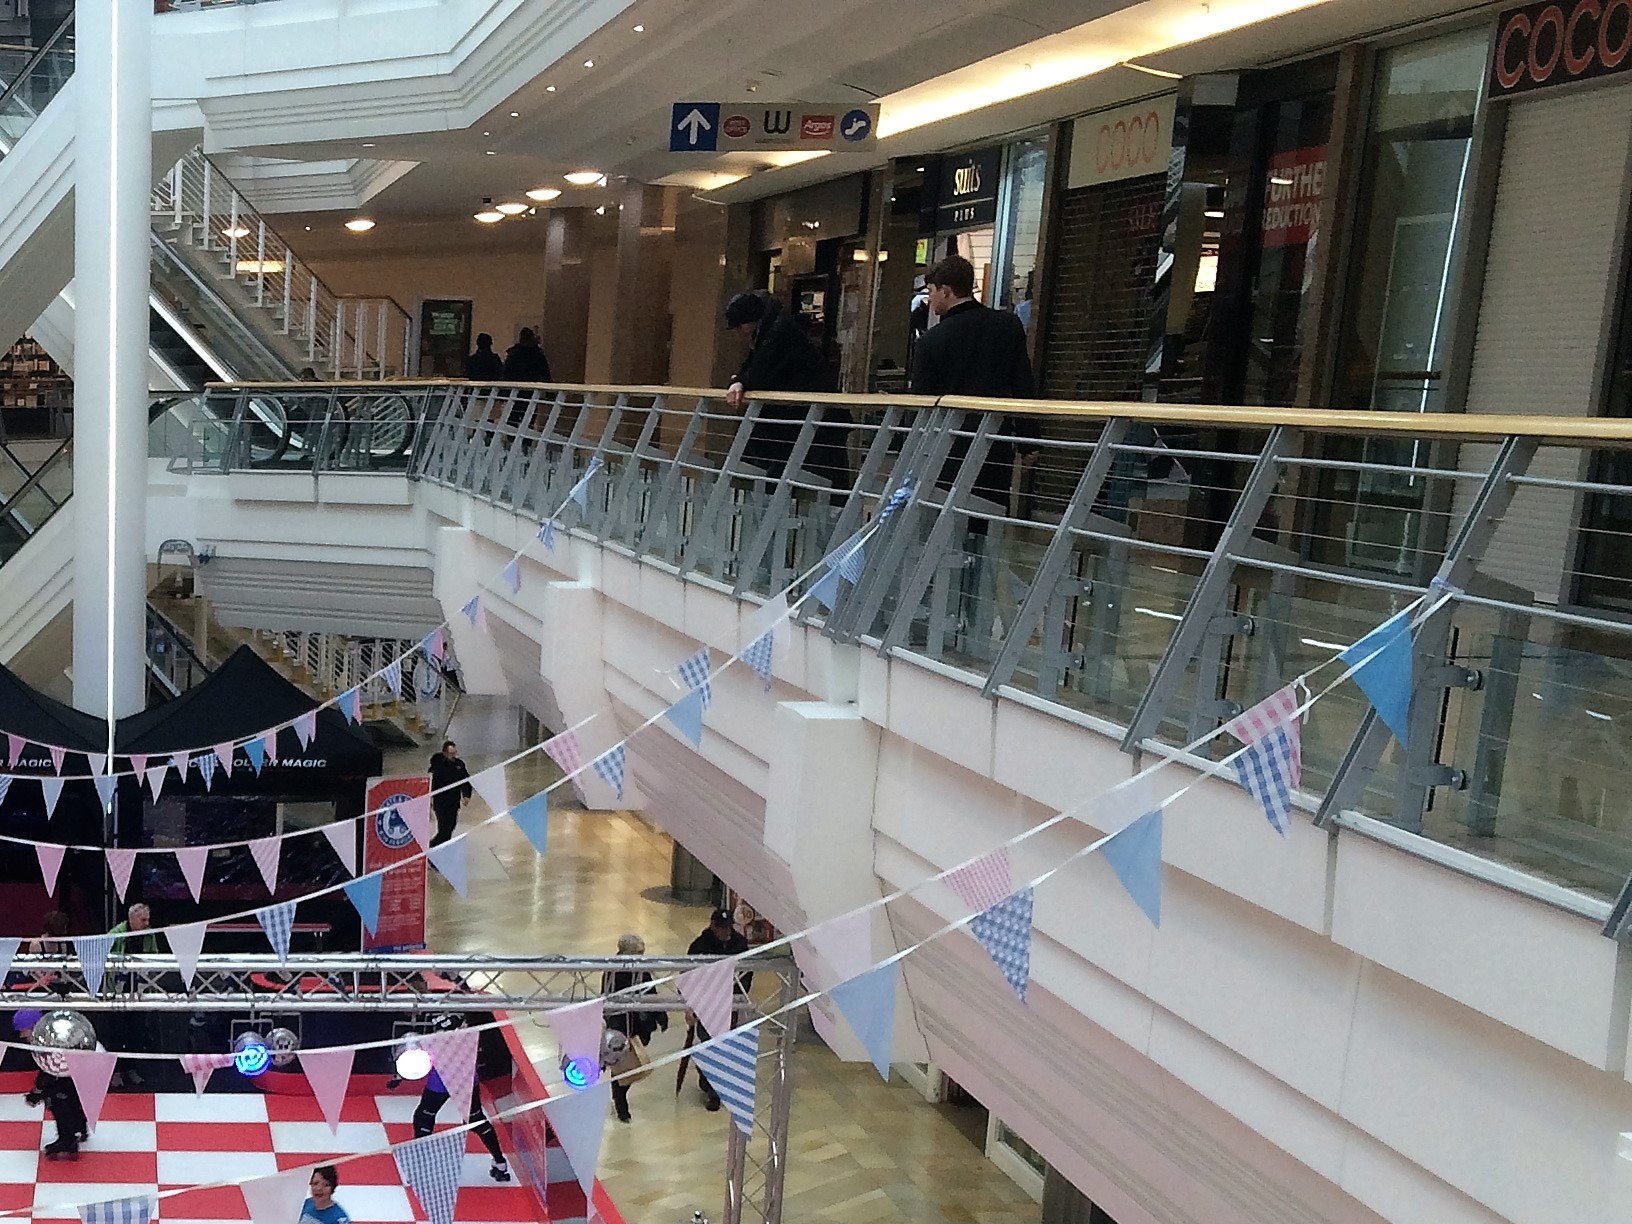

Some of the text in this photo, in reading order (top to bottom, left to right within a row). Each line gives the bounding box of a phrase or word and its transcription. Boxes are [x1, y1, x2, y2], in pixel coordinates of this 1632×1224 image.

[1496, 0, 1632, 89] COCO
[804, 119, 832, 131] Argos
[1096, 111, 1159, 174] COCO
[953, 158, 982, 196] suits
[953, 207, 975, 222] PLUS
[8, 757, 53, 768] AGIC
[281, 757, 327, 768] MAGIC
